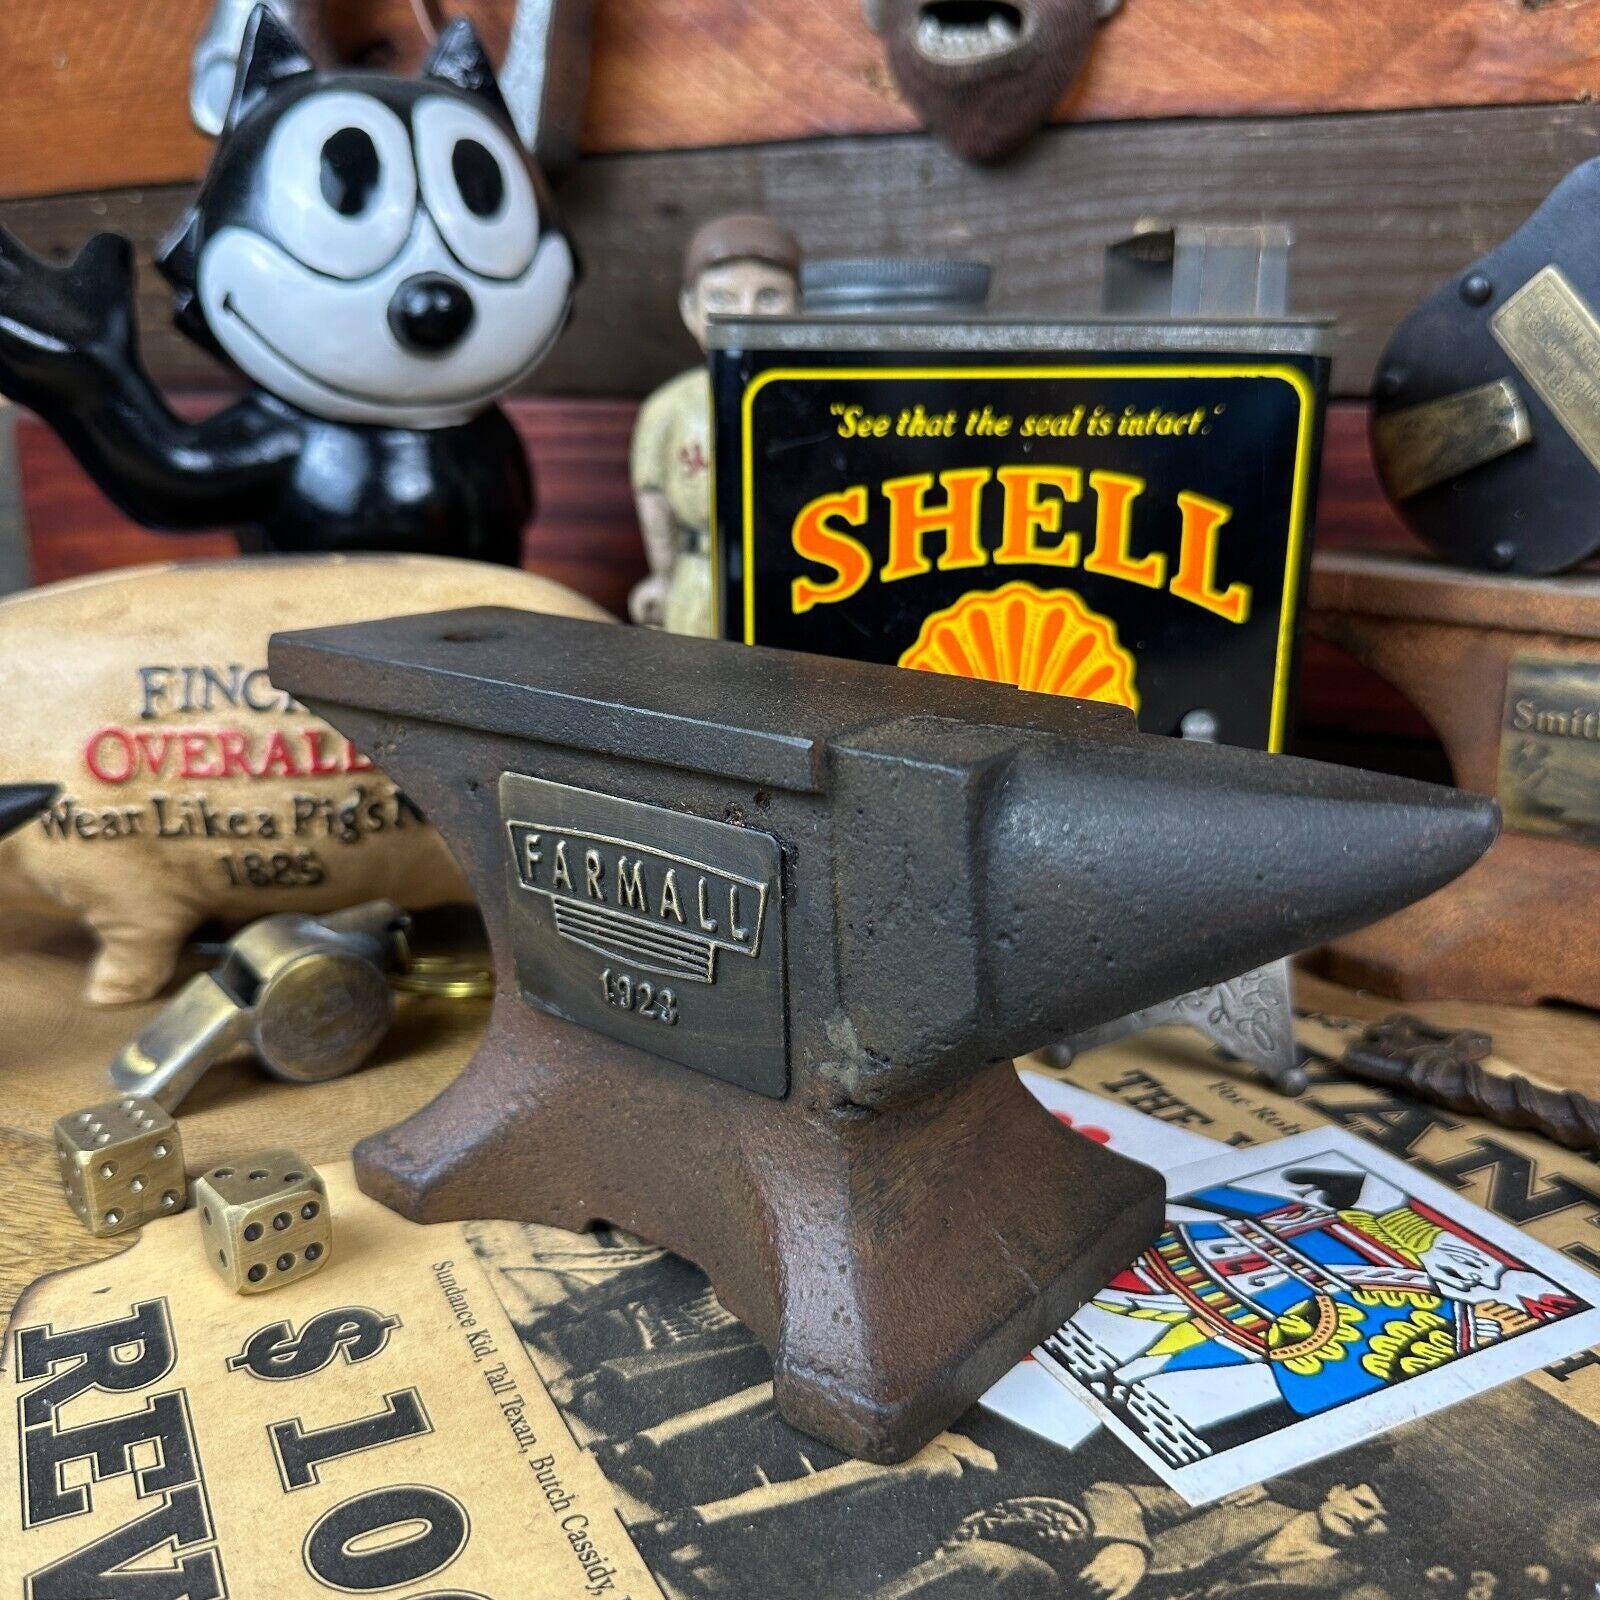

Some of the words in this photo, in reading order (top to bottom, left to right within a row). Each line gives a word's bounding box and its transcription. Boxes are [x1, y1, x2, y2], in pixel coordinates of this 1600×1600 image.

[896, 404, 957, 438] that
[965, 405, 1013, 437] the
[1020, 404, 1086, 437] seal
[1087, 404, 1115, 437] is
[791, 465, 1253, 625] SHELL
[139, 665, 308, 718] FINC
[1513, 699, 1600, 742] Smit
[40, 797, 142, 840] Wear
[292, 785, 386, 845] Pig's
[217, 851, 327, 888] 1885
[524, 833, 750, 942] FARMALL
[599, 967, 681, 1027] 1923
[432, 1260, 478, 1328] Sundance
[466, 1328, 498, 1363] Kid,
[483, 1362, 518, 1397] Tall
[226, 1306, 490, 1600] $10
[499, 1393, 538, 1454] Texan,
[528, 1453, 579, 1514] Butch
[560, 1513, 617, 1596] Cassidy,
